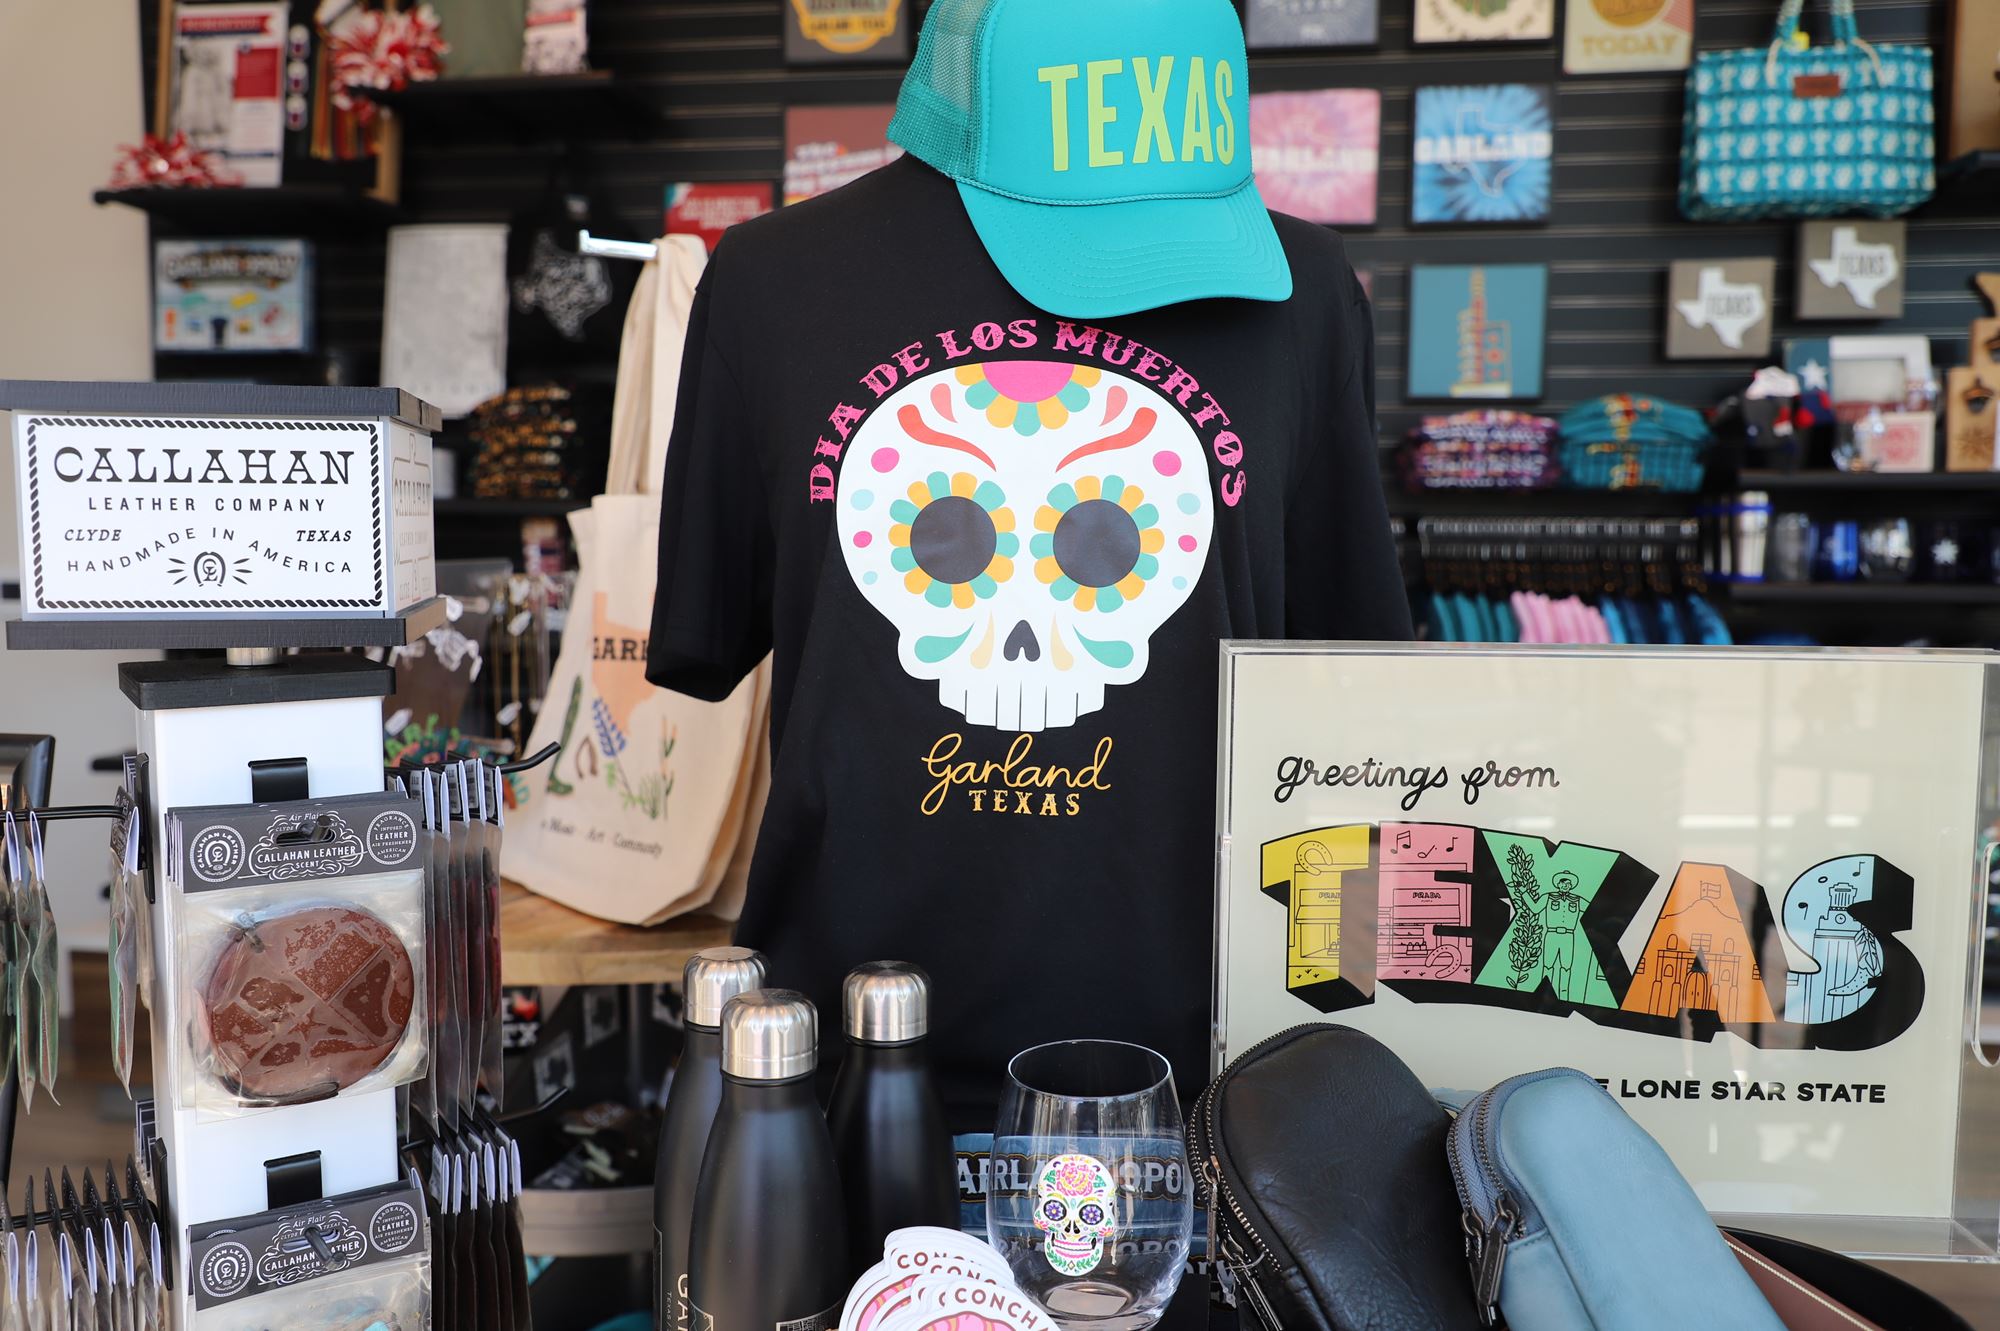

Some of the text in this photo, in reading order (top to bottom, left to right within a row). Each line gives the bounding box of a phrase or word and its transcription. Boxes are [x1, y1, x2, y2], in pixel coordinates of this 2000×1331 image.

[1581, 34, 1677, 56] TODAY
[1038, 55, 1235, 172] TEXAS
[1413, 131, 1553, 164] GARLAND
[809, 318, 1248, 508] DIA DE LOS MUERTOS
[54, 446, 355, 485] CALLAHAN
[88, 497, 325, 512] LEATHER COMPANY
[64, 529, 352, 543] CLYDE TEXAS
[67, 527, 352, 573] HANDMADE IN AMERICA
[920, 732, 1113, 816] Garland
[1274, 756, 1560, 812] greetings from
[968, 790, 1081, 816] TEXAS
[288, 814, 302, 822] Air
[373, 815, 410, 831] FRAGRANCE
[375, 831, 408, 841] LEATHER
[197, 832, 239, 869] CALLAHAN LEATHER
[257, 845, 356, 863] CALLAHAN LEATHER
[295, 860, 320, 869] SCENT
[1412, 891, 1442, 899] PRADA
[1260, 821, 1926, 1052] TEXAS
[502, 1022, 540, 1048] EX
[1620, 1078, 1701, 1099] LONE
[1711, 1080, 1786, 1102] STAR
[1796, 1082, 1887, 1104] STATE
[292, 1214, 326, 1229] Air Flair
[377, 1219, 410, 1232] LEATHER
[206, 1248, 247, 1286] CALLAHAN LEATHER
[264, 1240, 360, 1272] CALLAHAN ATHER
[302, 1260, 323, 1271] SCEN
